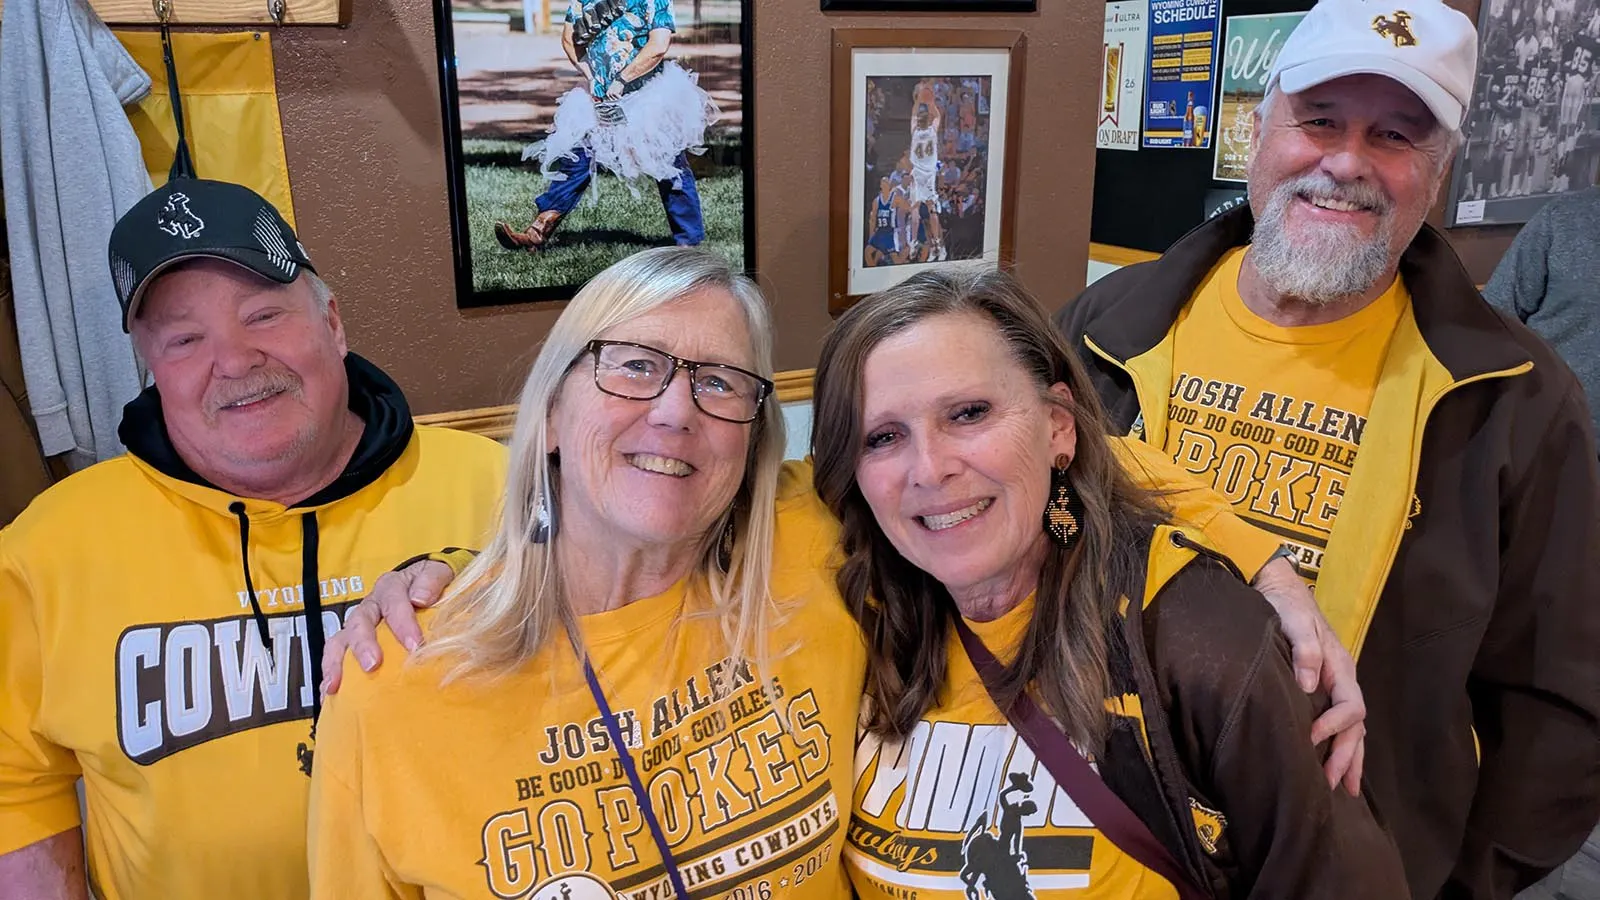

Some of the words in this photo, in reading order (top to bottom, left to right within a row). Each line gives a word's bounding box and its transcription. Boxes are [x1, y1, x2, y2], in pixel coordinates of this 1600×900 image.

[1119, 13, 1141, 21] ULTRA
[1152, 0, 1184, 10] WYOMING
[1154, 5, 1216, 24] SCHEDULE
[1571, 46, 1592, 73] 85
[1527, 77, 1546, 99] 86
[914, 140, 934, 159] 44
[1099, 130, 1111, 143] ON
[1111, 129, 1137, 144] DRAFT
[1170, 373, 1245, 413] JOSH
[1250, 390, 1367, 446] ALLEN
[1203, 413, 1226, 433] DO
[1230, 419, 1274, 445] GOOD
[1284, 433, 1319, 456] GOD
[1322, 443, 1357, 467] BLE
[1173, 428, 1350, 533] POKE
[237, 575, 364, 608] WYOING
[538, 709, 635, 765] JOSH
[650, 655, 756, 740] ALLEN
[515, 775, 544, 801] BE
[550, 761, 602, 794] GOOD
[642, 733, 682, 772] GOOD
[691, 709, 726, 742] GOD
[728, 676, 785, 724] BLESS
[475, 798, 594, 900] GO
[596, 687, 832, 872] POKES
[632, 857, 726, 900] WYOING
[736, 801, 834, 867] COWBOYS
[727, 880, 771, 900] 016
[793, 843, 833, 887] 2017
